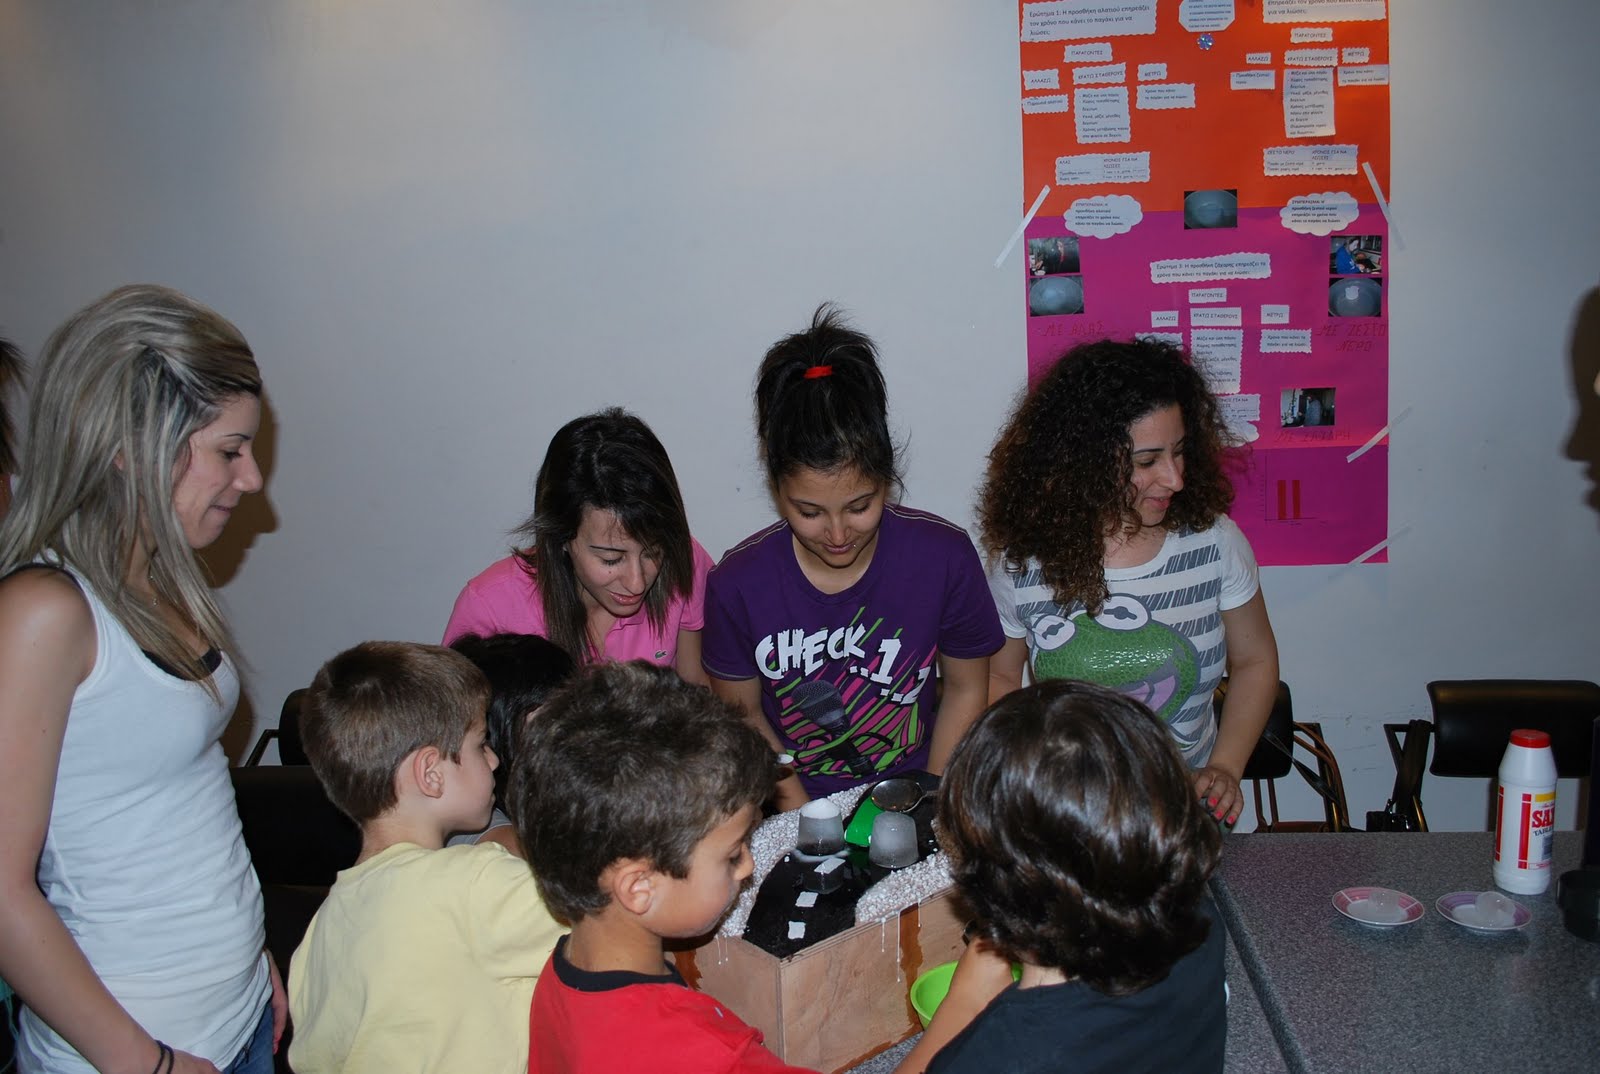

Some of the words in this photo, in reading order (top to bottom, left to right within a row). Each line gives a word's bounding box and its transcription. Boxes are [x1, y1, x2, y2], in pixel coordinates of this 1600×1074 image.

[1030, 10, 1054, 18] Ερώτημα
[1068, 7, 1096, 16] προσθήκη
[755, 623, 866, 680] CHECK
